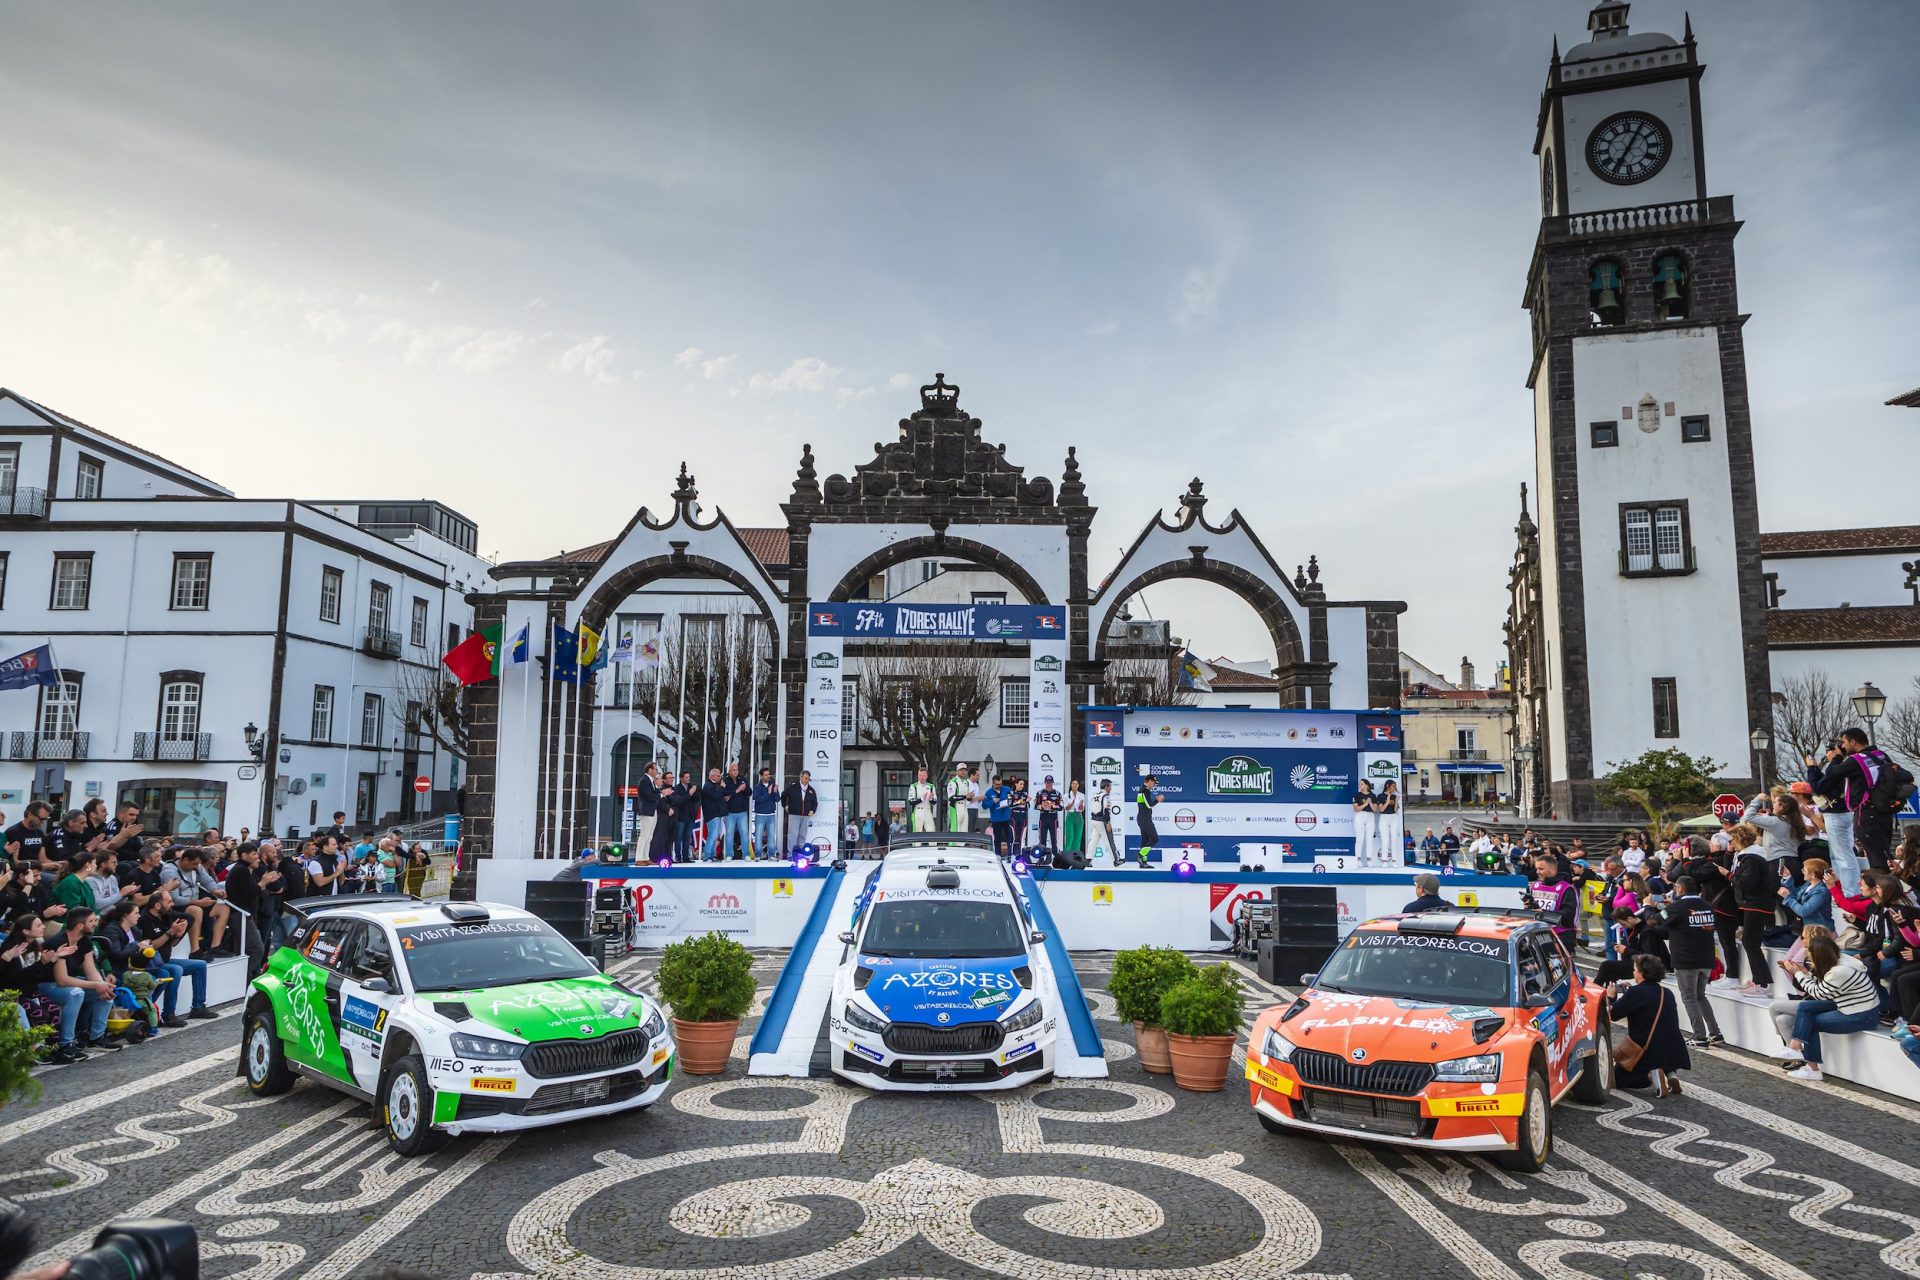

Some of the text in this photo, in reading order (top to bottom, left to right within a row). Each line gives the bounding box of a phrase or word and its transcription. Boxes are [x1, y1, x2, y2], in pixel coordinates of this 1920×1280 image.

[855, 609, 885, 631] 57th
[895, 607, 976, 636] AZORES RALLYE
[809, 729, 838, 740] MEO
[1033, 732, 1062, 743] MEO
[1135, 727, 1150, 735] FIA
[1330, 729, 1344, 737] FIA
[1091, 762, 1121, 774] AZORES RALLYE
[1231, 759, 1248, 773] 57th
[1368, 765, 1398, 777] AZORES RALLYE
[1209, 770, 1271, 793] AZORES RALLYE
[1714, 803, 1744, 814] STOP
[1182, 850, 1189, 861] 2
[1261, 845, 1267, 856] 1
[1337, 858, 1344, 870] 3
[879, 891, 886, 901] 1
[401, 922, 542, 949] 2 VISITAZORES.COM
[304, 929, 319, 957] 2
[1359, 935, 1500, 956] VISITAZORES.COM
[882, 971, 1014, 991] AZORES
[938, 989, 960, 997] NATURE
[983, 988, 990, 996] 1
[488, 985, 629, 1017] AZORES
[913, 1002, 974, 1010] VISITAZORES.COM
[284, 963, 326, 1059] AZORES
[375, 1009, 387, 1032] 2
[548, 1014, 612, 1028] VISITAZORES.COM
[1300, 1016, 1446, 1031] FLASH LED
[430, 1058, 464, 1073] MEO
[473, 1079, 512, 1090] PIRELLI
[1257, 1069, 1278, 1088] PIRELLI
[1456, 1099, 1500, 1113] PIRELLI
